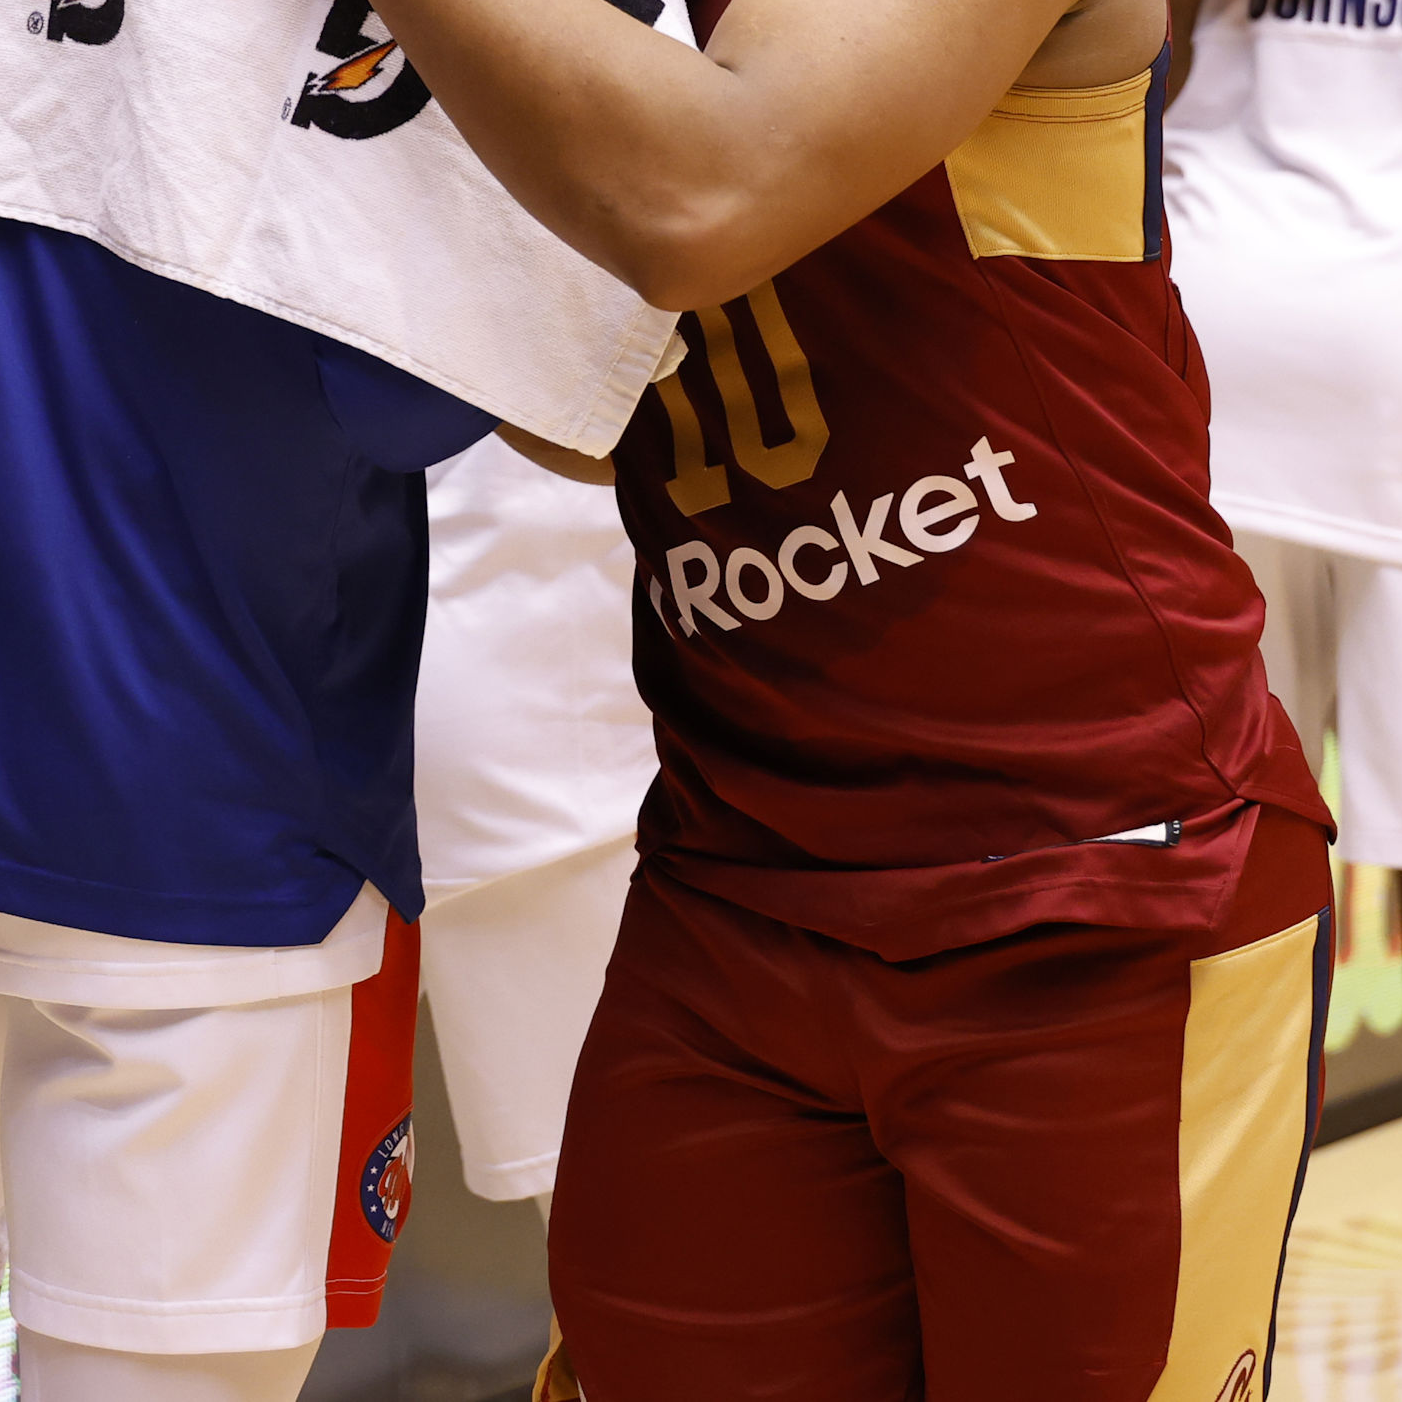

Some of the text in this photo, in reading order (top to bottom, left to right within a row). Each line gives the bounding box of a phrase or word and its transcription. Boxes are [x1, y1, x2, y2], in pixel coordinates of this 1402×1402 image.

[651, 279, 830, 518] 10
[665, 435, 1038, 638] Rocket
[378, 1123, 404, 1158] LONG
